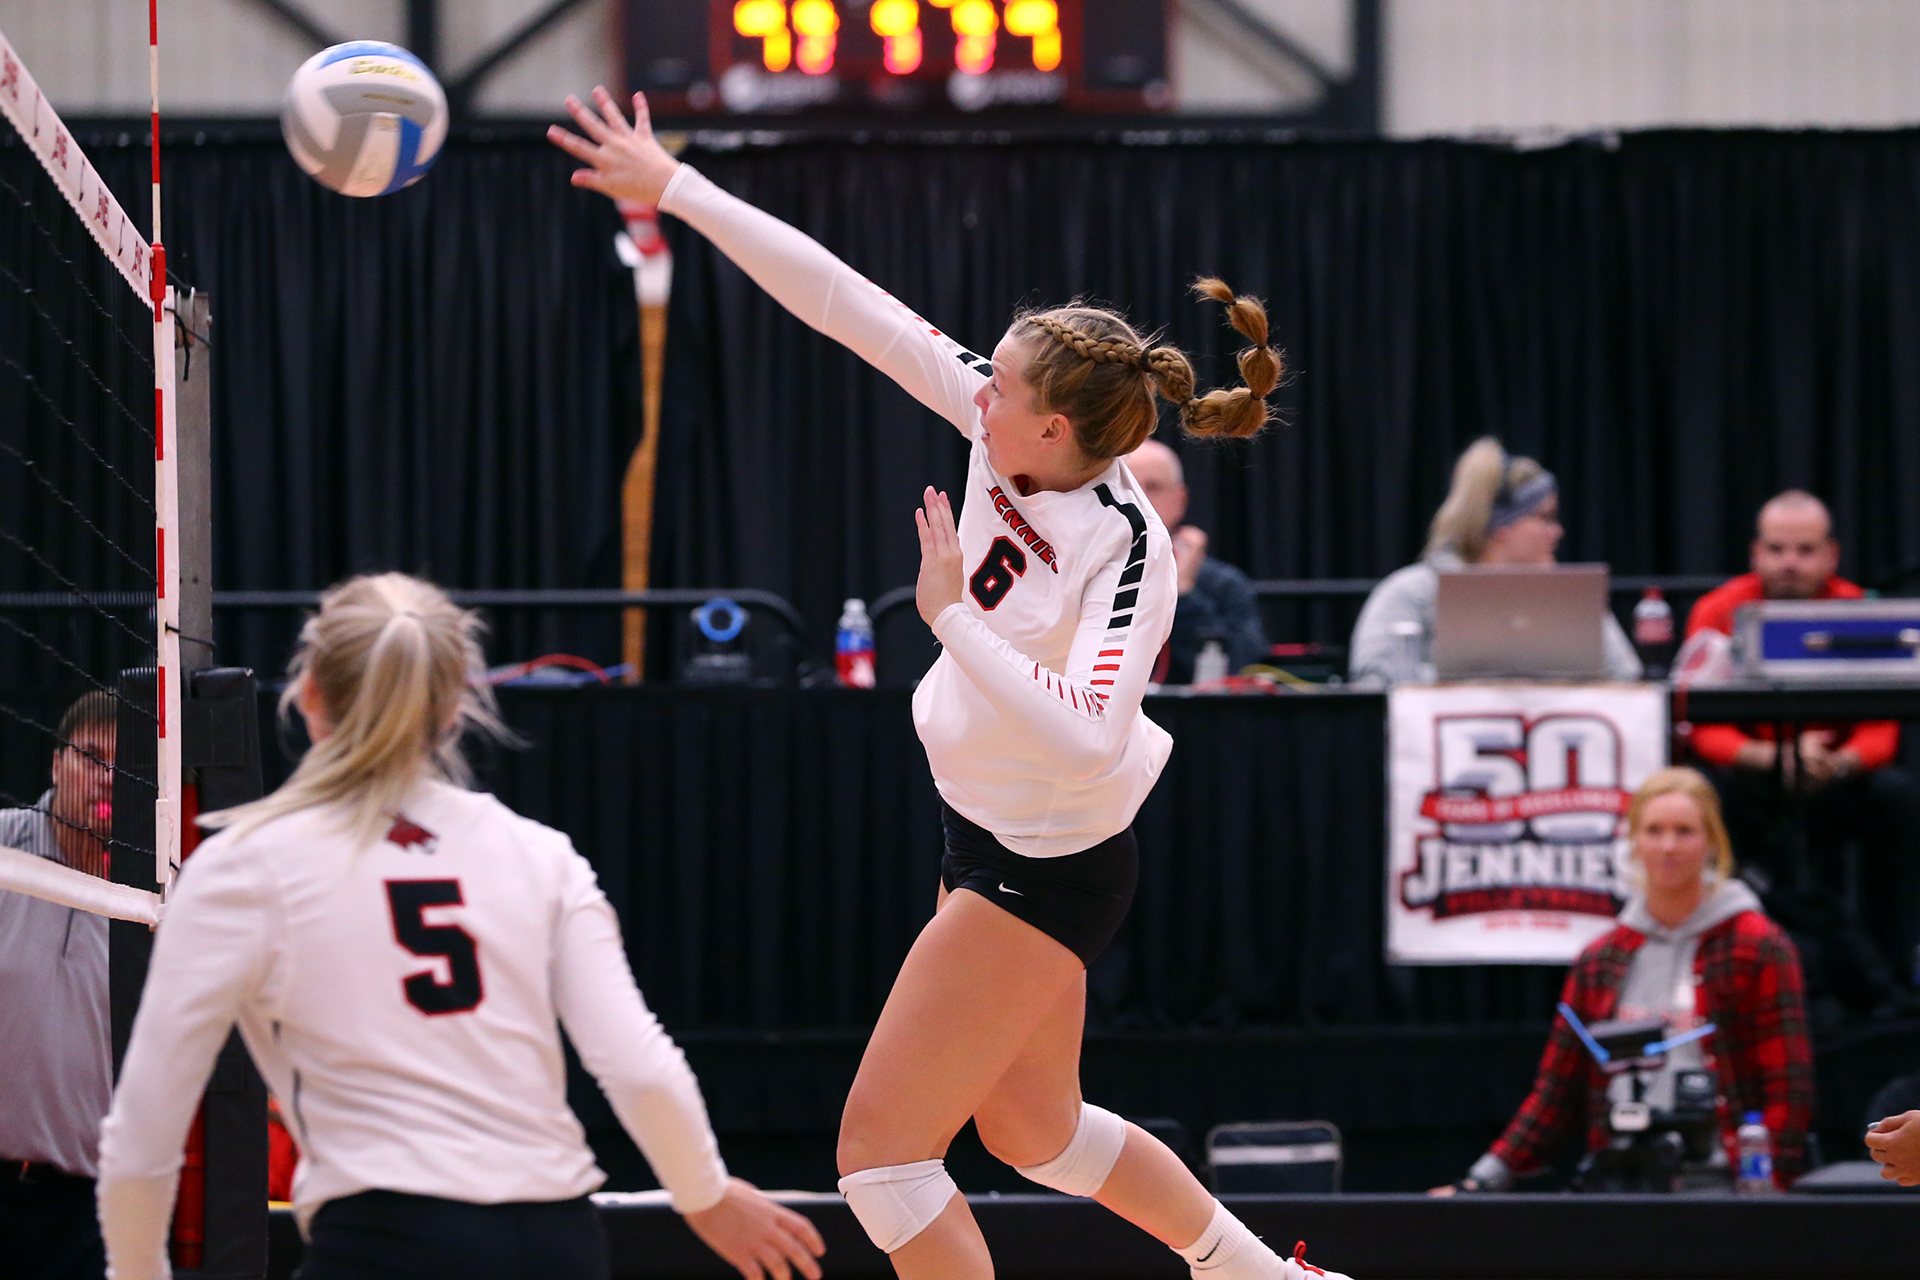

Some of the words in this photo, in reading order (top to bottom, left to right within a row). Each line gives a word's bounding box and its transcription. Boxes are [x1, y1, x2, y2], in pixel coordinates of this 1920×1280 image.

[969, 535, 1027, 612] 6
[1434, 712, 1622, 842] 50
[383, 877, 485, 1016] 5
